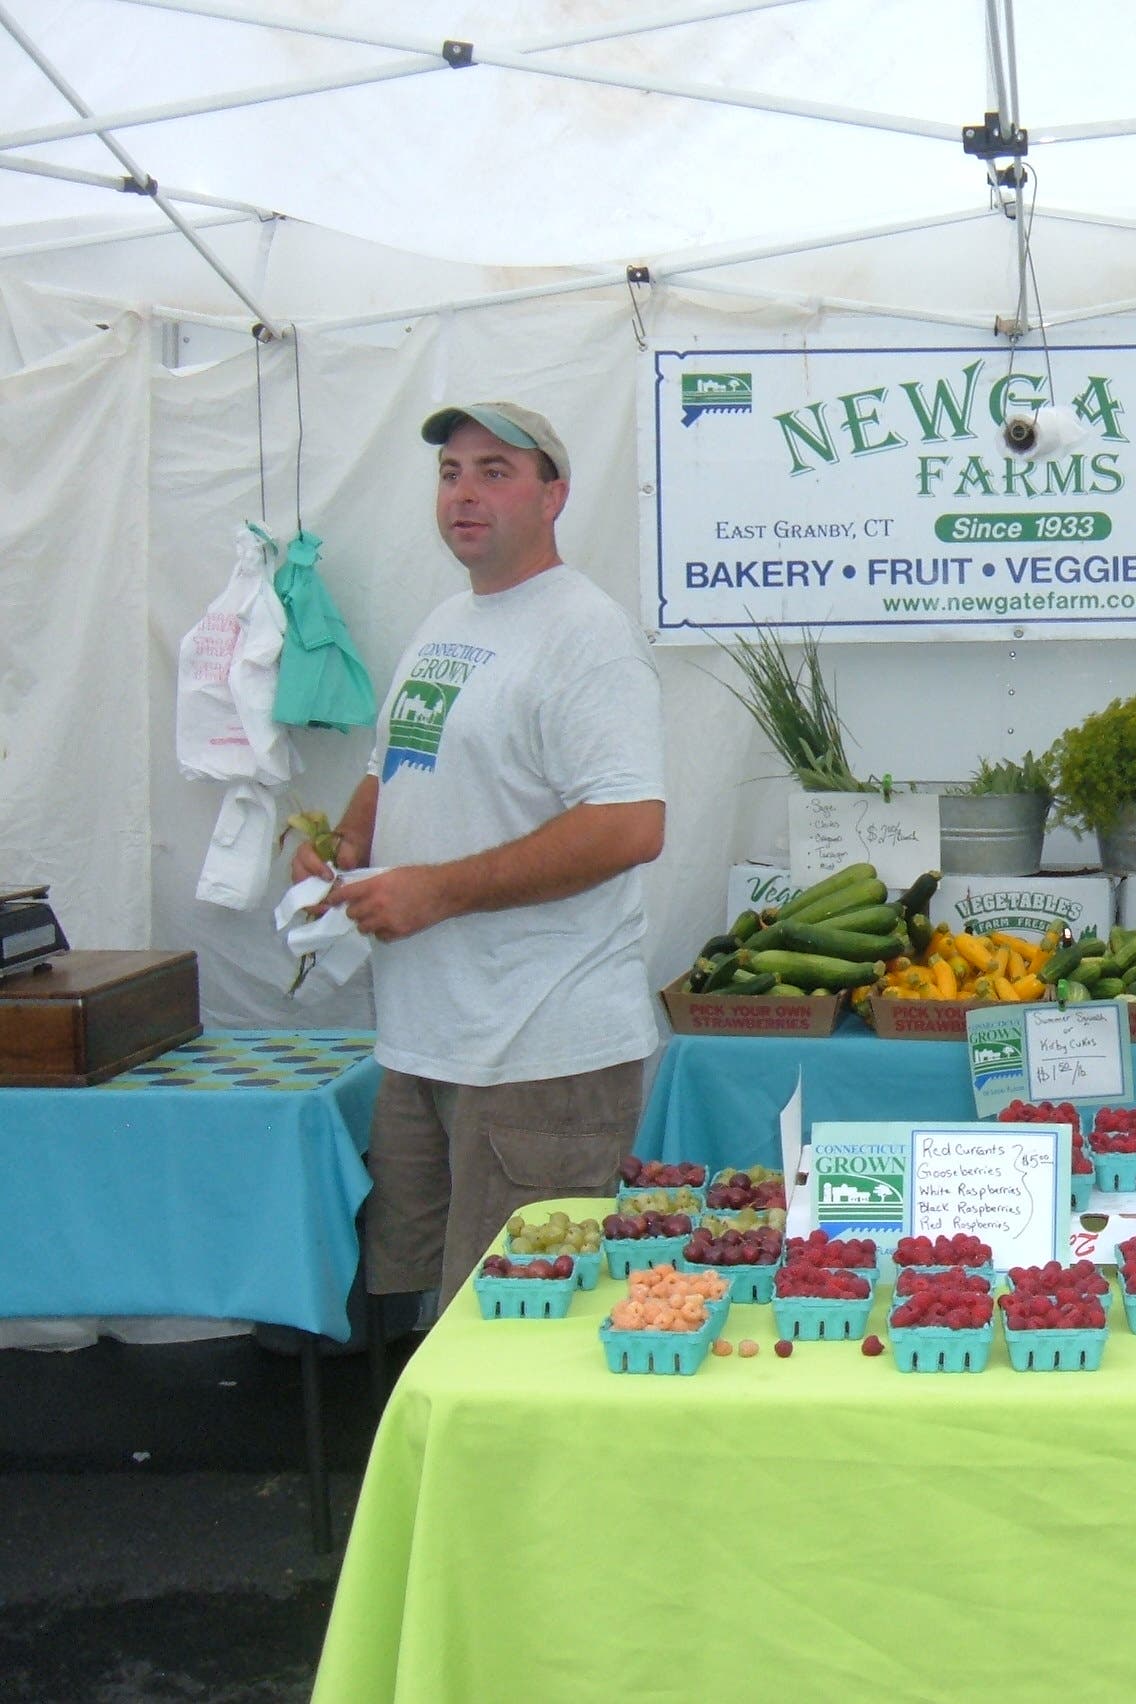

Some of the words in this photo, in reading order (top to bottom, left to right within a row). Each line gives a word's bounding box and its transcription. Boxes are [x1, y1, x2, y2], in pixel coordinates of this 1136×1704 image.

[916, 453, 1125, 499] FARMS
[716, 520, 767, 539] EAST
[864, 518, 895, 538] CT
[952, 516, 1022, 540] Since
[1035, 515, 1095, 538] 1933
[686, 559, 834, 589] BAKERY
[868, 557, 973, 585] FRUIT
[418, 642, 497, 665] CONNECTICUT
[410, 658, 477, 684] GROWN
[955, 891, 1084, 922] VEGETABLES
[1017, 917, 1051, 931] FRES
[689, 1003, 725, 1017] PICK
[731, 1004, 771, 1017] YOUR
[775, 1004, 812, 1018] OWN
[892, 1006, 929, 1019] PICK
[934, 1006, 968, 1019] YOU
[692, 1017, 811, 1030] STRAWBERRIES
[969, 1027, 1023, 1045] GROWN
[816, 1143, 906, 1155] CONNECTICUT
[922, 1138, 951, 1158] Red
[815, 1156, 906, 1175] GROWN
[916, 1161, 1003, 1180] Gooseberries
[919, 1184, 951, 1196] White
[957, 1183, 1022, 1203] Raspberries
[918, 1200, 949, 1214] Black
[957, 1202, 1022, 1217] Raspberries
[920, 1216, 942, 1231] Red
[952, 1216, 1011, 1233] Raspberries
